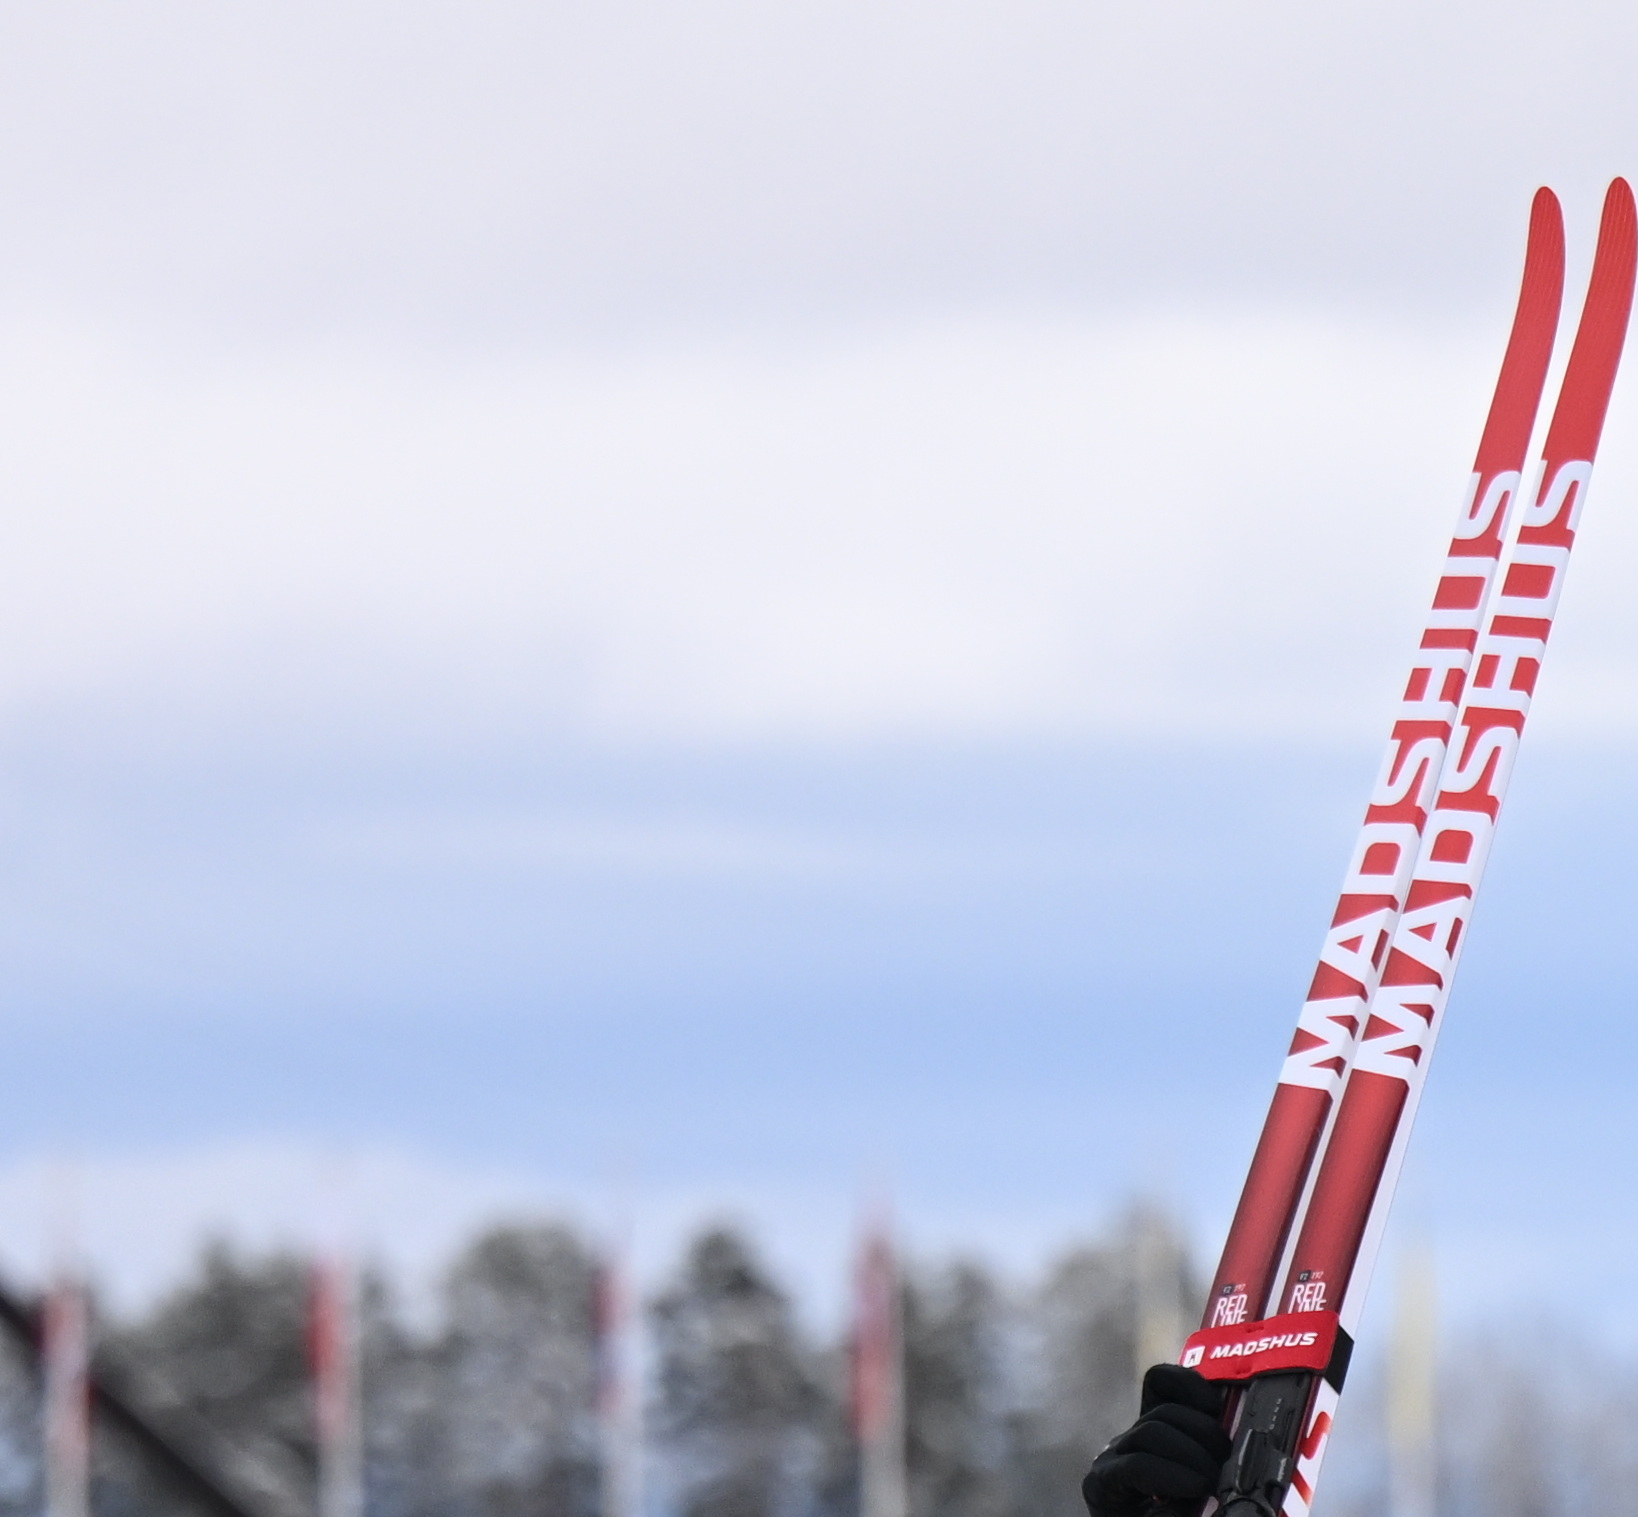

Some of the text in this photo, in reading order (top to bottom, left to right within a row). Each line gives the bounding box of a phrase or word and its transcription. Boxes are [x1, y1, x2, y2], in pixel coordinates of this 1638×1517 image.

[1279, 469, 1521, 1086] MADSHUS
[1352, 458, 1594, 1080] MADSHUS
[1210, 1333, 1318, 1359] MADSHUS
